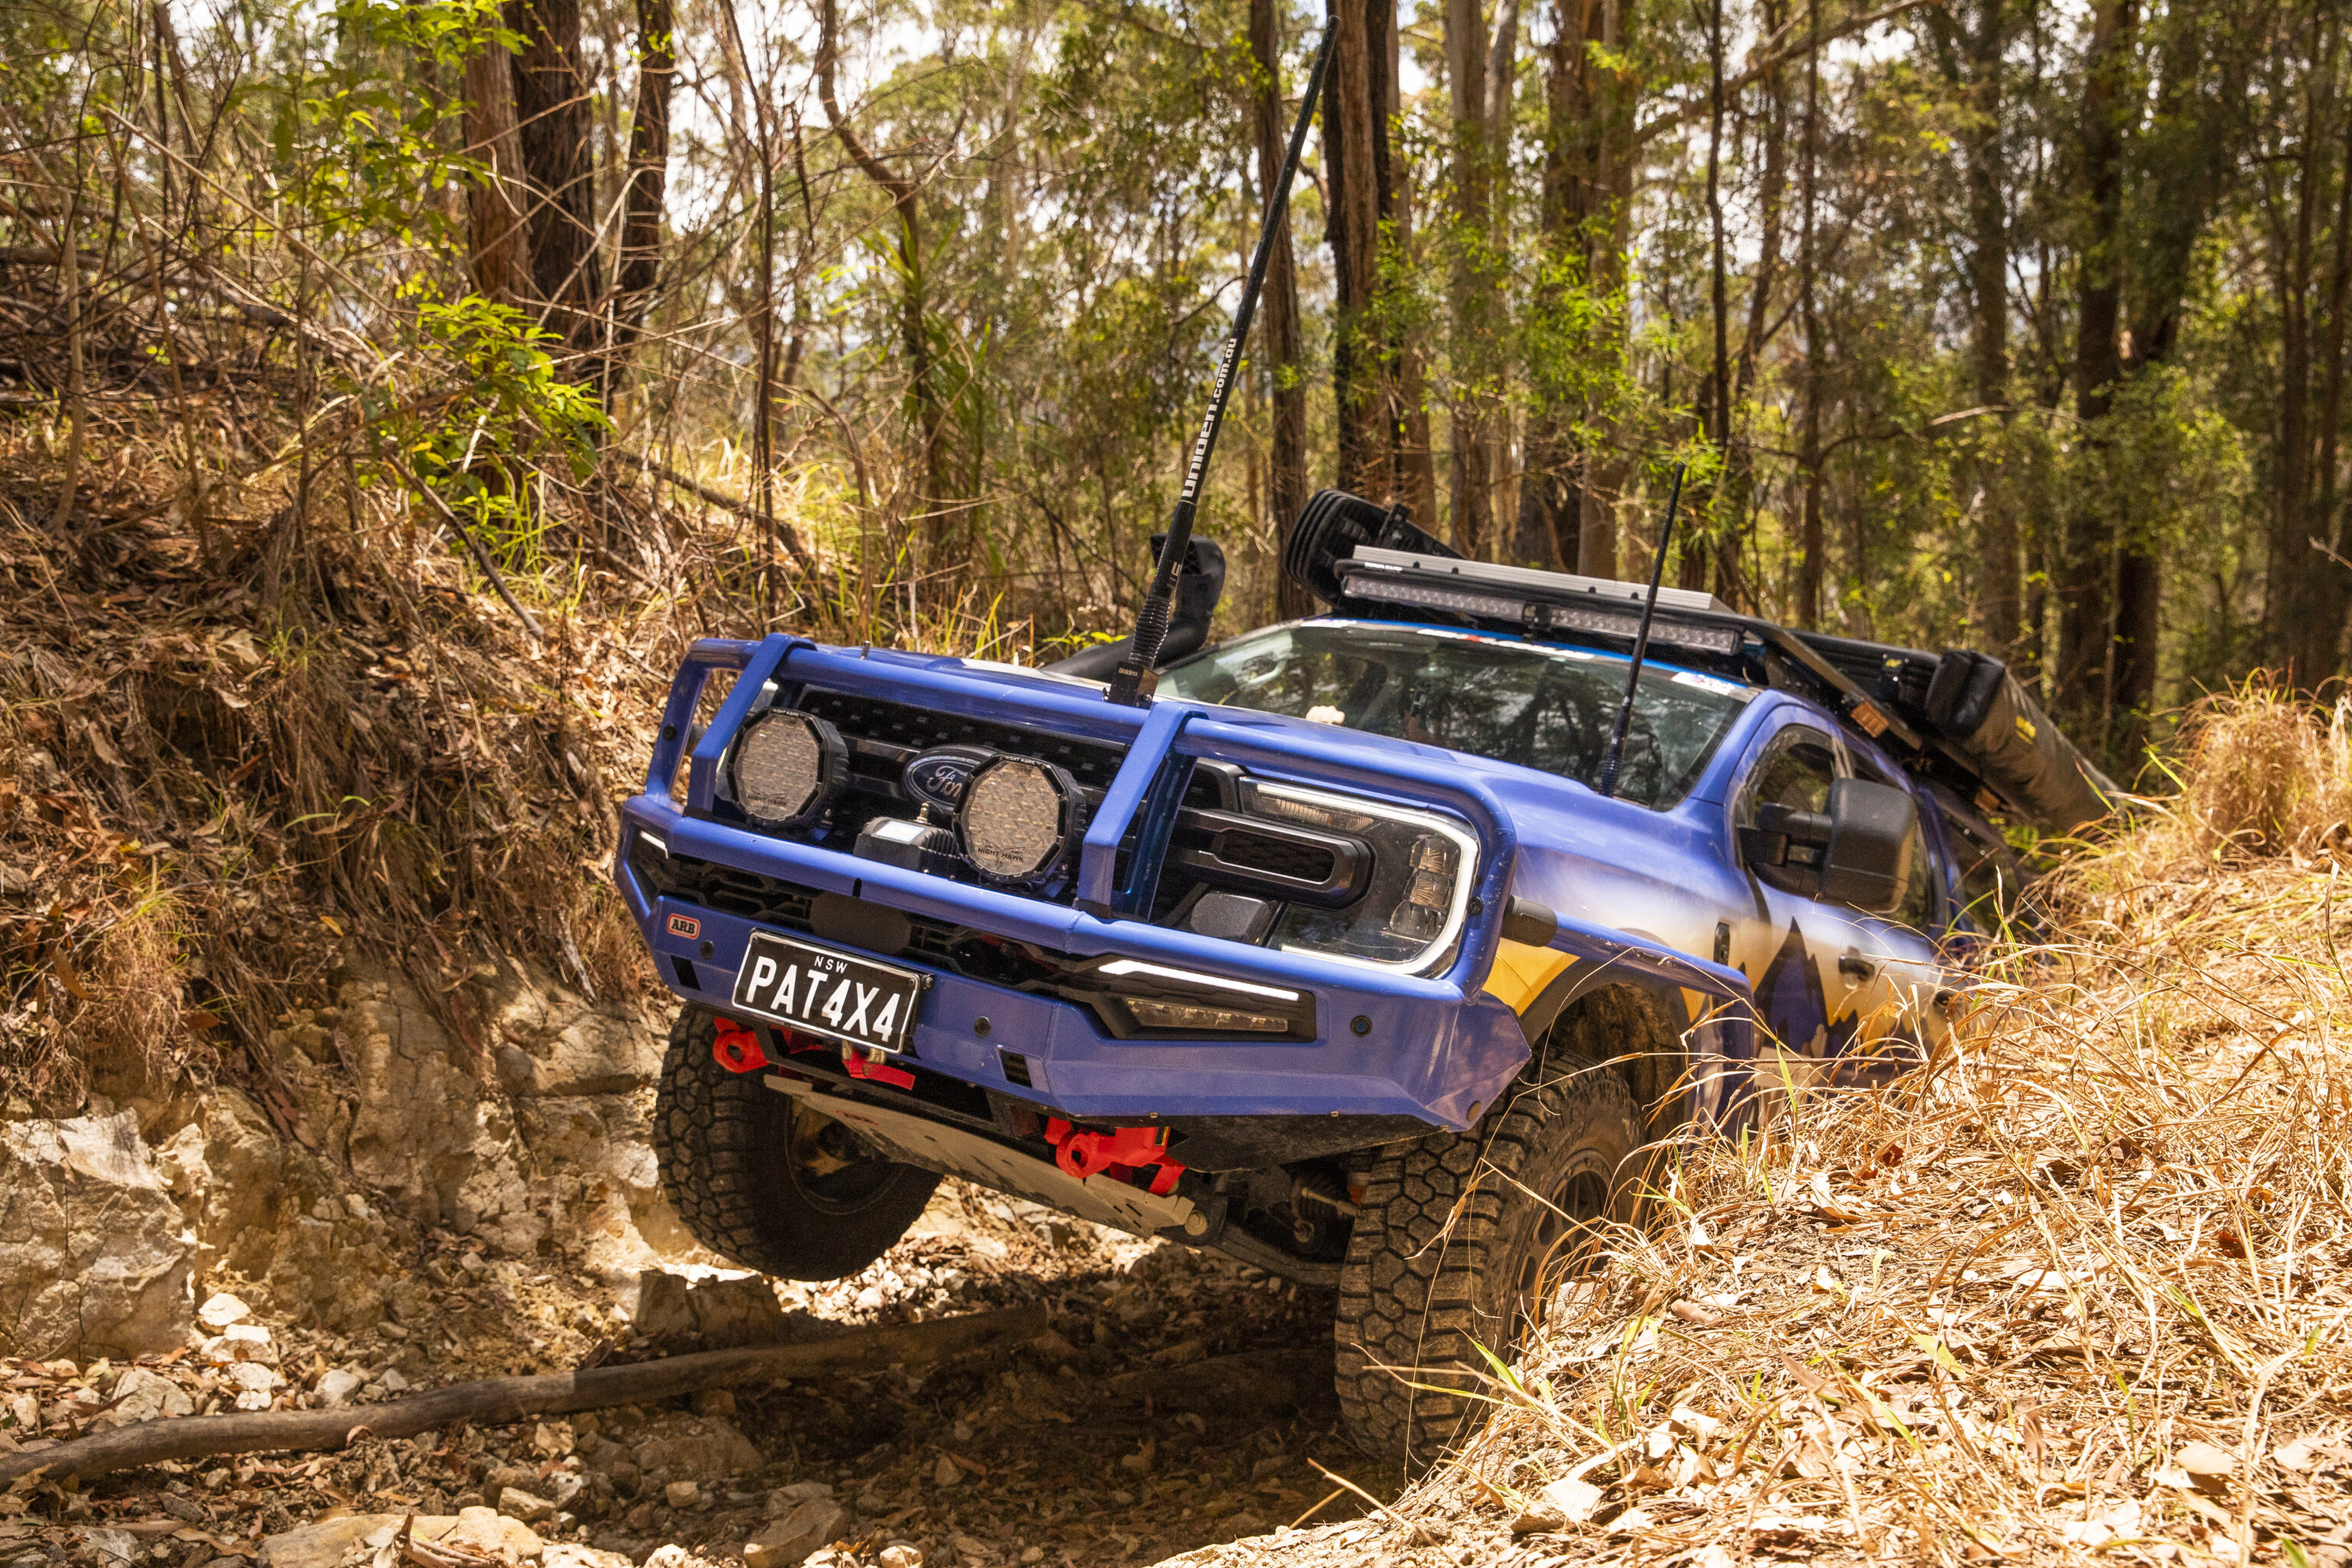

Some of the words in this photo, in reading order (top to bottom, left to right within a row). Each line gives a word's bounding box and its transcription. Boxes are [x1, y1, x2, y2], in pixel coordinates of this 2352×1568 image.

[978, 847, 1000, 857] NIGHT
[1001, 852, 1024, 862] HAWK
[671, 919, 695, 934] ARB
[814, 955, 848, 974] NSW
[746, 956, 900, 1042] PAT4X4
